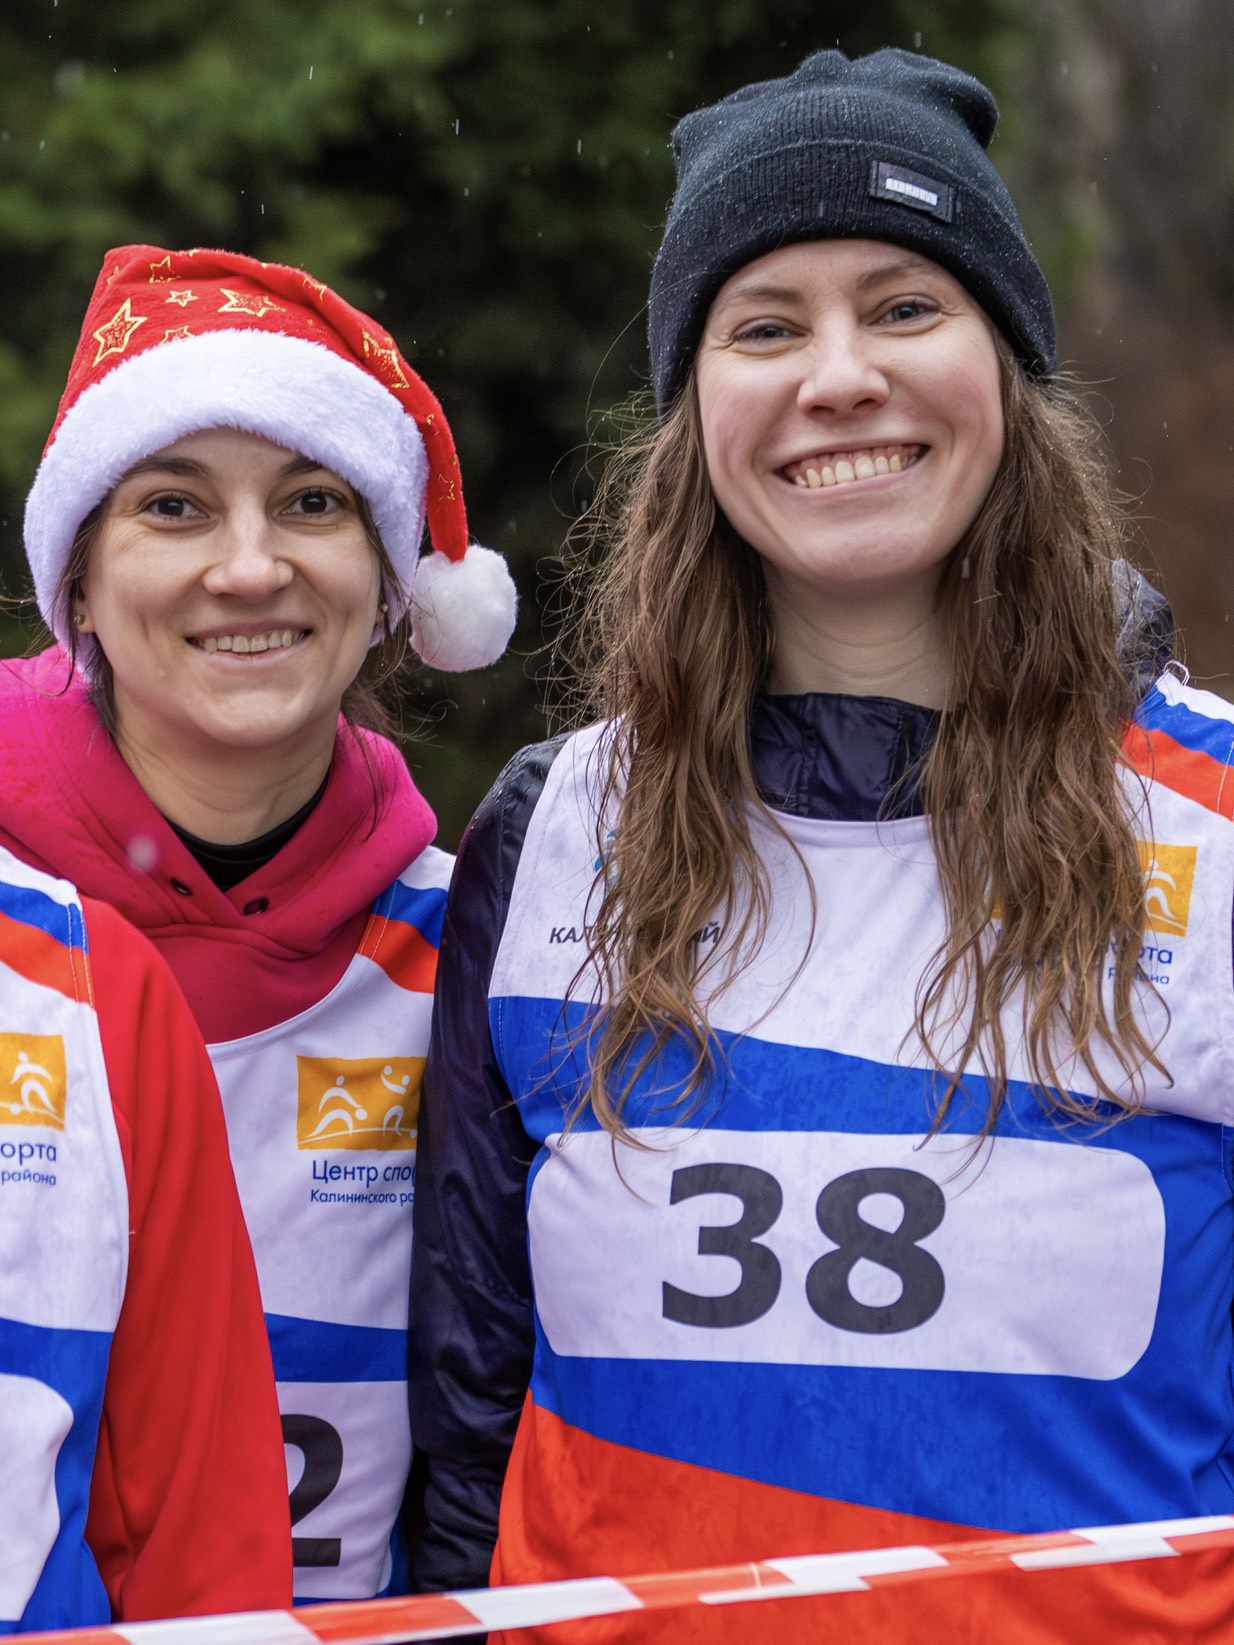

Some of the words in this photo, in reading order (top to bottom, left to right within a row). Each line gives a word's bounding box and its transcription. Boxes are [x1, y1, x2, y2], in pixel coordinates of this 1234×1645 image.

[2, 1169, 56, 1186] района
[312, 1160, 379, 1188] Центр
[311, 1189, 397, 1204] Калининского
[662, 1162, 946, 1335] 38
